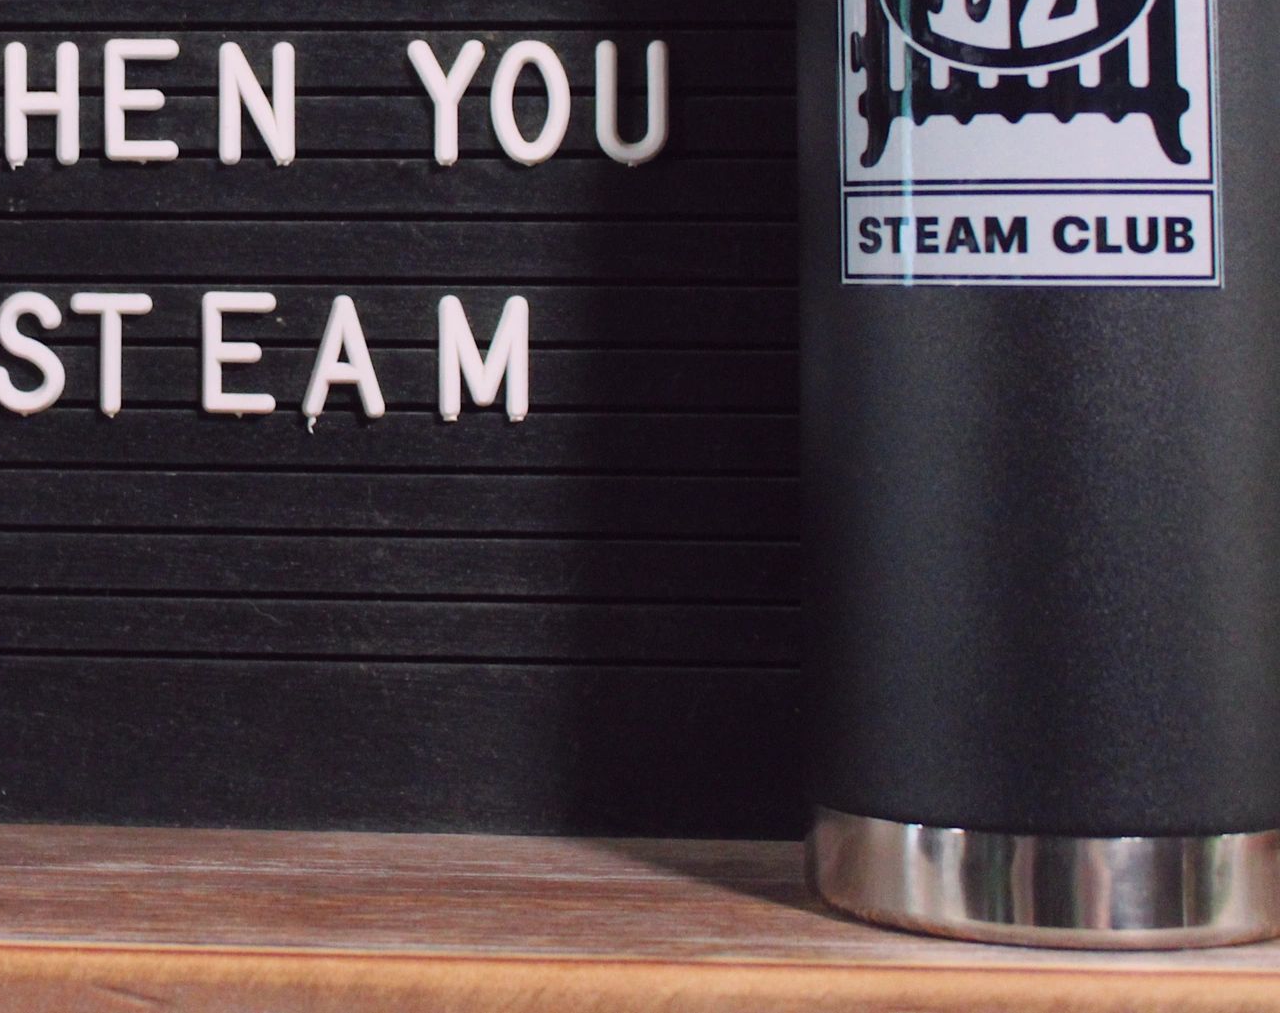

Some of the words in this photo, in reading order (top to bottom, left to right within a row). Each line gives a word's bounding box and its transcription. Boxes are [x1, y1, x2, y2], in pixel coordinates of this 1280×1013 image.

[406, 39, 668, 166] YOU
[858, 216, 1028, 255] STEAM
[1052, 215, 1195, 254] CLUB
